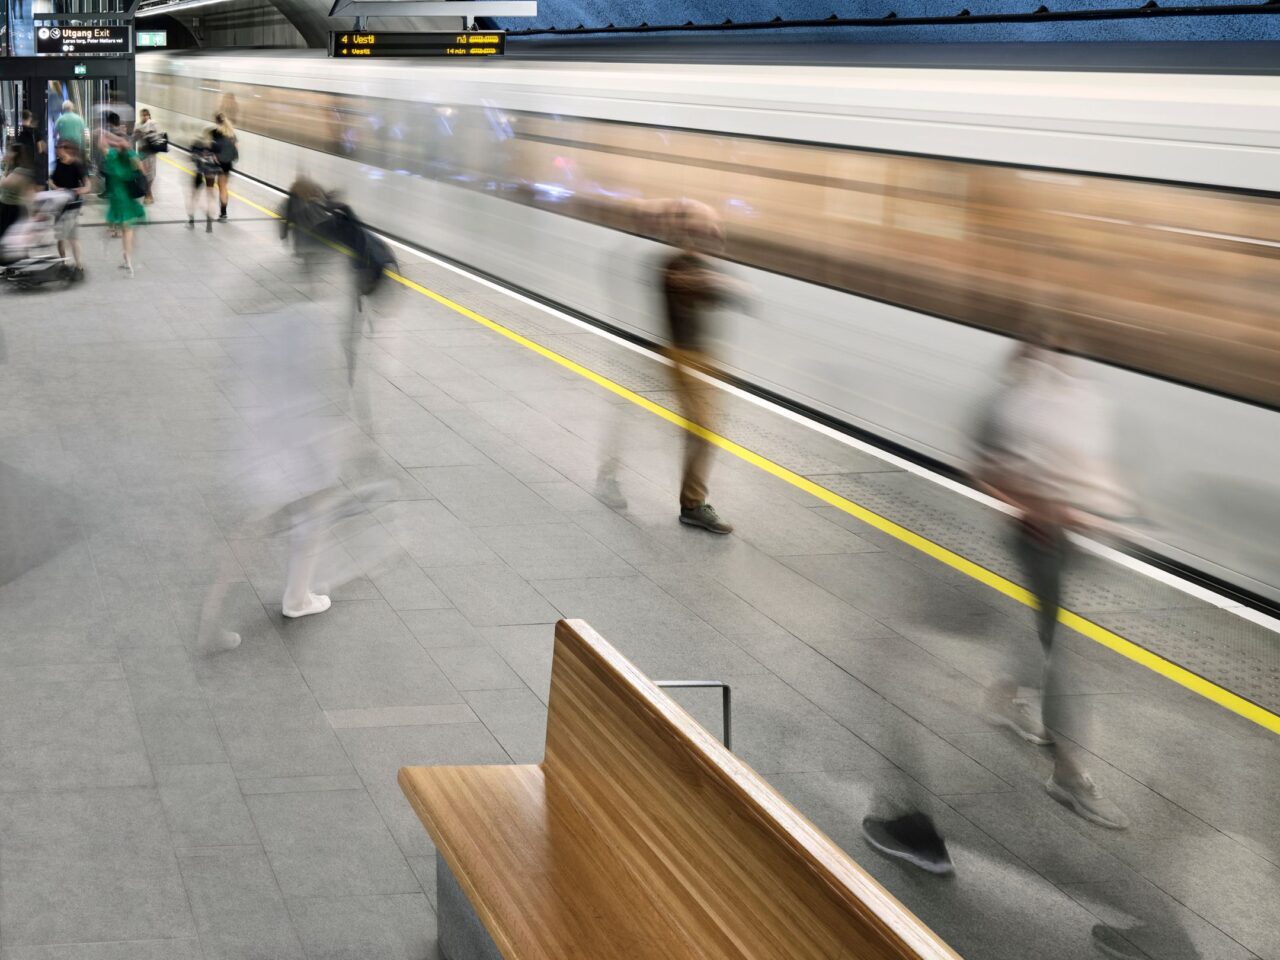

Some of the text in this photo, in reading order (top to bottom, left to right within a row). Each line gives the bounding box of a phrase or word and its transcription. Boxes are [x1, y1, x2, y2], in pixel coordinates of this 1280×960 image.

[62, 29, 110, 39] Utgang Exit
[341, 34, 348, 44] 4
[457, 34, 467, 44] nå
